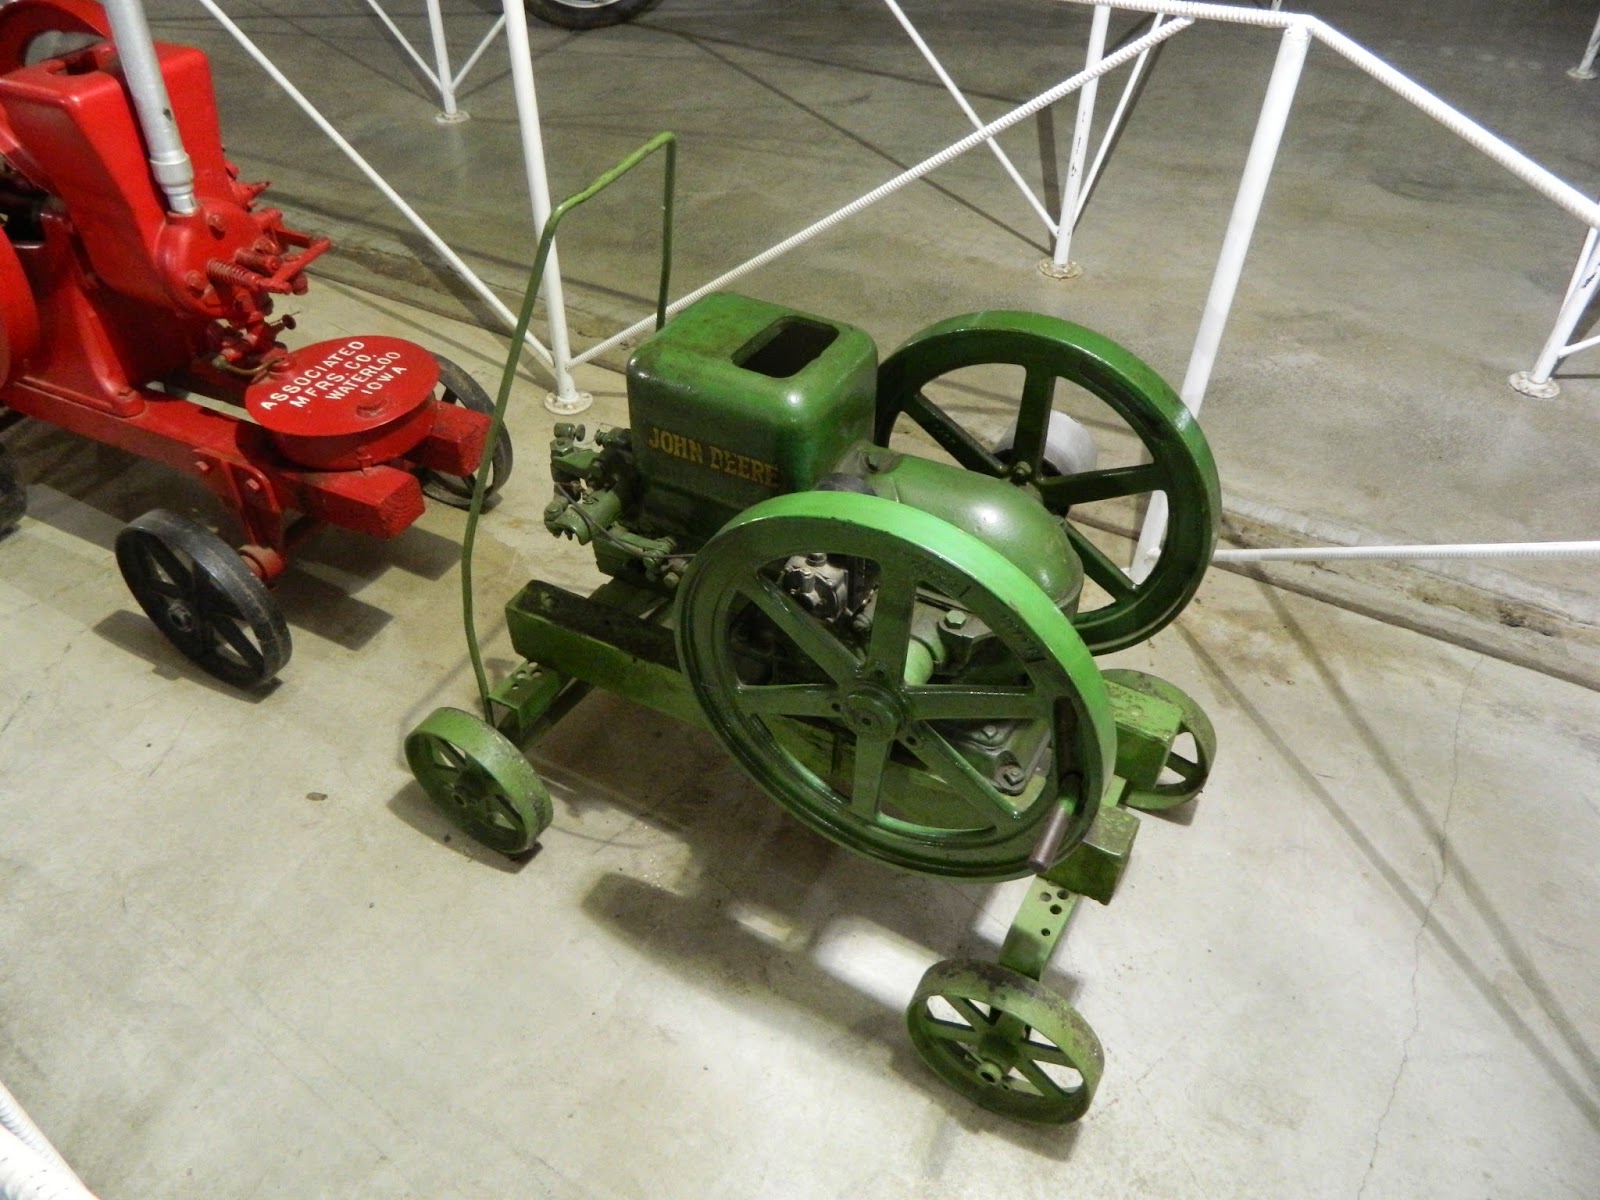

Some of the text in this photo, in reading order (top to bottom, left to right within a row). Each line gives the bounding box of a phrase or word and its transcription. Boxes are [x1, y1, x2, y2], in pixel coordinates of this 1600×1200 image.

[260, 341, 365, 410] ASSOCIATED
[325, 351, 401, 401] WATERLOO
[344, 354, 377, 371] CO.
[361, 366, 407, 395] IOWA
[648, 427, 779, 488] JOHN DEERE
